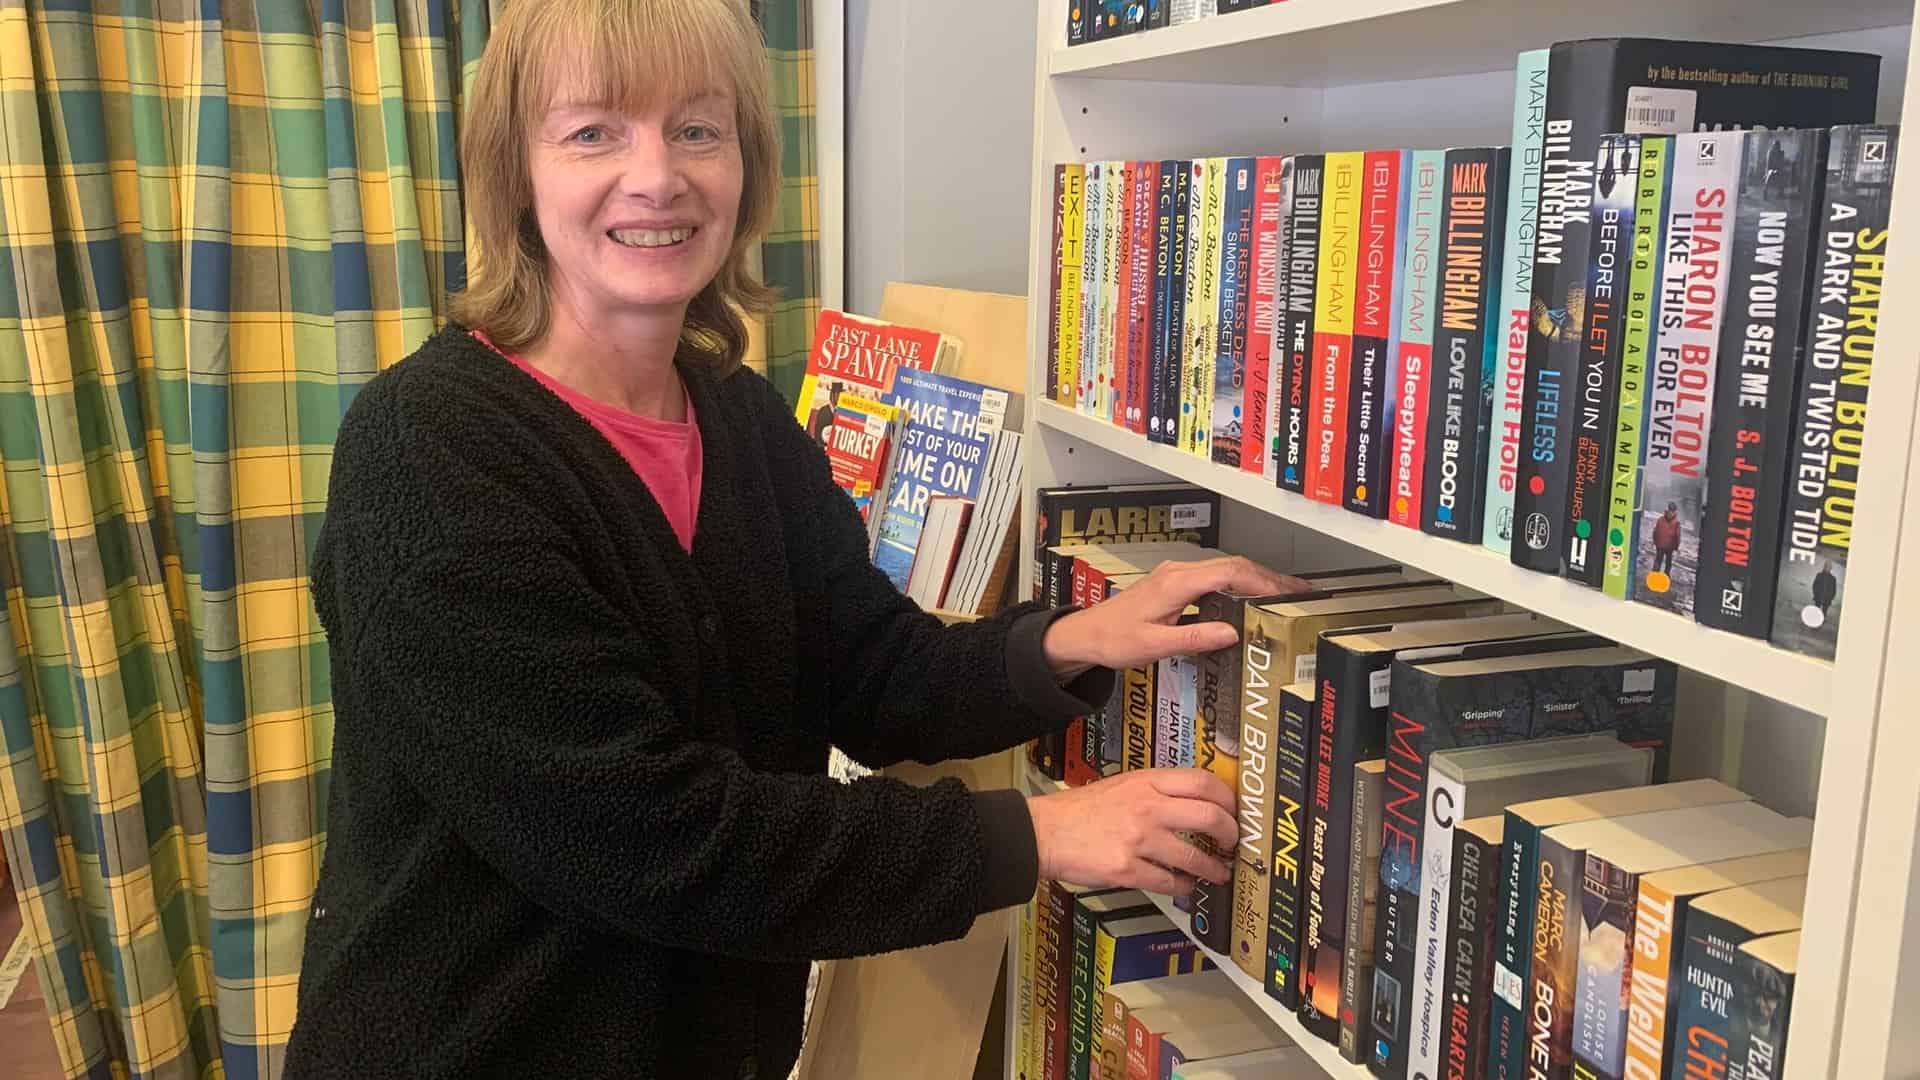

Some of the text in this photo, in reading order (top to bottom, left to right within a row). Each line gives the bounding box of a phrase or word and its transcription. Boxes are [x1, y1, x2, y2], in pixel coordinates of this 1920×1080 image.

[1647, 64, 1659, 82] by
[1661, 65, 1676, 80] the
[1678, 66, 1728, 86] bestselling
[1730, 71, 1760, 85] author
[1761, 72, 1772, 85] of
[1134, 183, 1143, 227] DEATH
[1142, 181, 1151, 229] DEATH
[1452, 162, 1488, 193] MARK
[1514, 69, 1546, 294] MARK BILLINGHAM
[1537, 120, 1573, 264] BILLINGHAM
[1562, 161, 1594, 225] MARK
[1635, 150, 1658, 270] ROBERTO
[1064, 175, 1080, 377] EXIT BELINDA BAUER
[1122, 209, 1132, 265] BEATON
[1158, 216, 1170, 276] BEATON
[1174, 215, 1186, 276] BEATON
[1187, 231, 1199, 304] Beaton
[1205, 231, 1217, 301] Beaton
[1254, 202, 1279, 334] THE WINDSOR KNOT
[1277, 216, 1293, 350] NOVEMBER ROAD
[1288, 168, 1320, 313] MARK BILLINGHAM
[1328, 171, 1352, 323] BILLINGHAM
[1364, 168, 1389, 327] BILLINGHAM
[1409, 168, 1434, 333] BILLINGHAM
[1442, 197, 1487, 330] BILLINGHAM
[1594, 209, 1619, 300] BEFORE
[1172, 300, 1180, 335] DEATH
[1222, 231, 1238, 357] SIMON BECKETT
[1232, 208, 1250, 389] THE RESTLESS DEAD
[1588, 313, 1609, 358] LET
[1650, 213, 1693, 460] LIKE THIS, FOR EVER
[1669, 188, 1726, 478] SHARON BOLTON
[1738, 211, 1788, 408] NOW YOU SEE ME
[1839, 228, 1889, 387] SHARON
[829, 323, 922, 361] FAST LANE
[1169, 363, 1177, 389] LIAR
[1322, 345, 1339, 425] From the
[1585, 361, 1605, 404] YOU
[1624, 292, 1646, 392] BOLAÑO
[1789, 203, 1857, 565] A DARK AND TWISTED TIDE
[894, 394, 948, 431] MAKE
[1288, 319, 1306, 465] THE DYING HOURS
[1356, 347, 1376, 483] Their Little Secret
[1398, 356, 1421, 497] Sleepyhead
[1439, 337, 1467, 508] LOVE LIKE BLOOD
[1498, 309, 1530, 492] Rabbit Hole
[1532, 369, 1560, 463] LIFELESS
[1582, 407, 1601, 431] IN
[831, 424, 880, 462] TURKEY
[897, 447, 938, 484] IME
[940, 461, 973, 495] ON
[925, 434, 981, 465] OF YOUR
[1571, 436, 1588, 522] BLACKHURS
[1586, 436, 1600, 483] JENNY
[1612, 421, 1634, 524] AMULET
[1061, 505, 1171, 538] LARR
[1723, 429, 1761, 567] S. J. BOLTON
[1127, 679, 1147, 723] YOU
[1180, 716, 1192, 764] DIGITAL
[1201, 671, 1218, 773] BROWN
[1316, 679, 1336, 811] JAMES LEE BURKE
[1239, 643, 1271, 855] DAN BROWN
[1383, 711, 1425, 866] MINE
[1275, 793, 1302, 887] MINE
[1307, 816, 1328, 950] Feast Day of Fools
[1458, 840, 1481, 935] CHELSEA
[1384, 893, 1400, 963] BUTLER
[1506, 839, 1523, 938] Everything
[1534, 860, 1554, 963] CAMERON
[1550, 887, 1567, 953] MARC
[1036, 900, 1051, 1008] LEE CHILD
[1045, 914, 1060, 1032] LEE CHILD
[1074, 935, 1089, 984] LEE
[1420, 887, 1441, 1058] Eden Valley Hospice
[1626, 892, 1673, 1063] The Well
[1071, 985, 1088, 1054] CHILD
[1529, 978, 1554, 1072] BONE
[1582, 965, 1598, 1052] CANDLISH
[1594, 999, 1607, 1061] LOUISE
[1700, 989, 1729, 1019] EVIL
